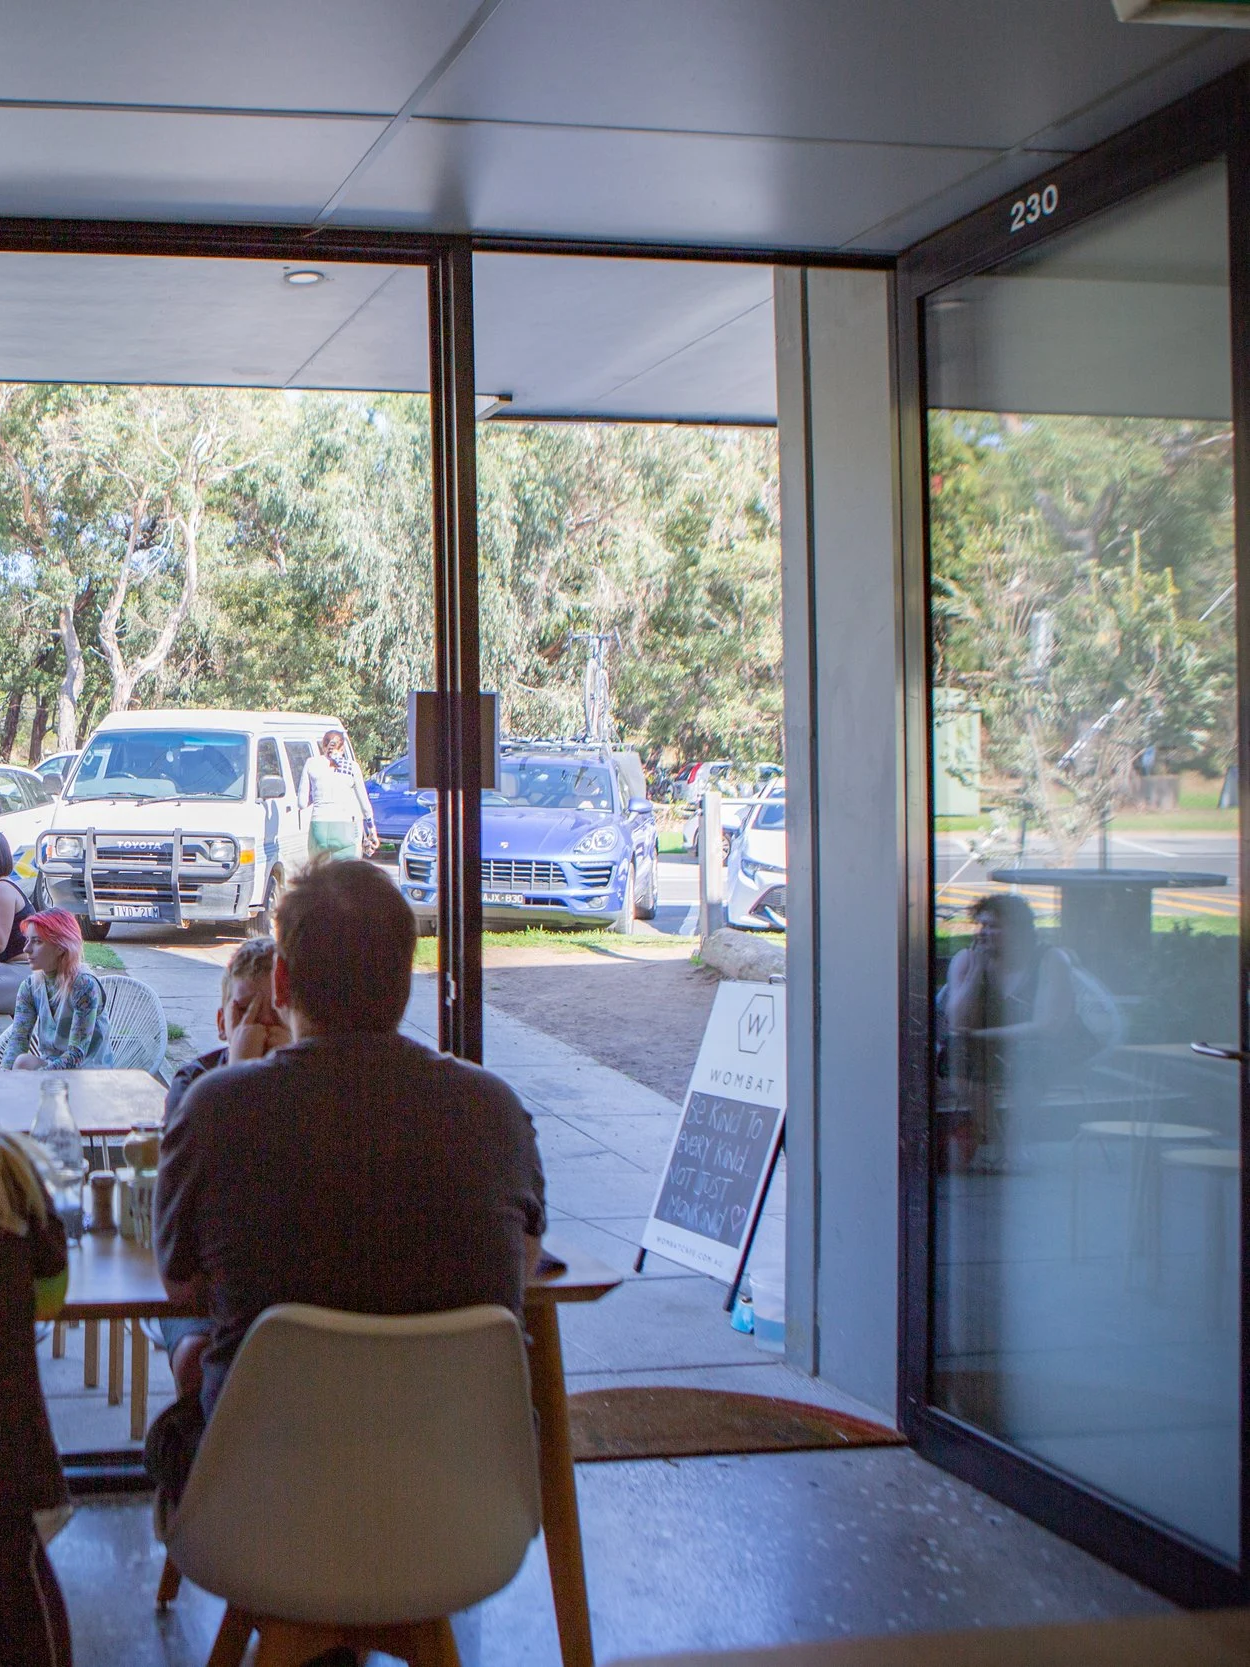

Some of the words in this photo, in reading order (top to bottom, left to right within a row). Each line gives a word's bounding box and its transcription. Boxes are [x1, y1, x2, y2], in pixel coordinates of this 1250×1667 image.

[1010, 184, 1059, 232] 230
[116, 840, 162, 850] TOYOTA
[747, 1013, 768, 1037] W
[710, 1068, 775, 1095] WOMBAT
